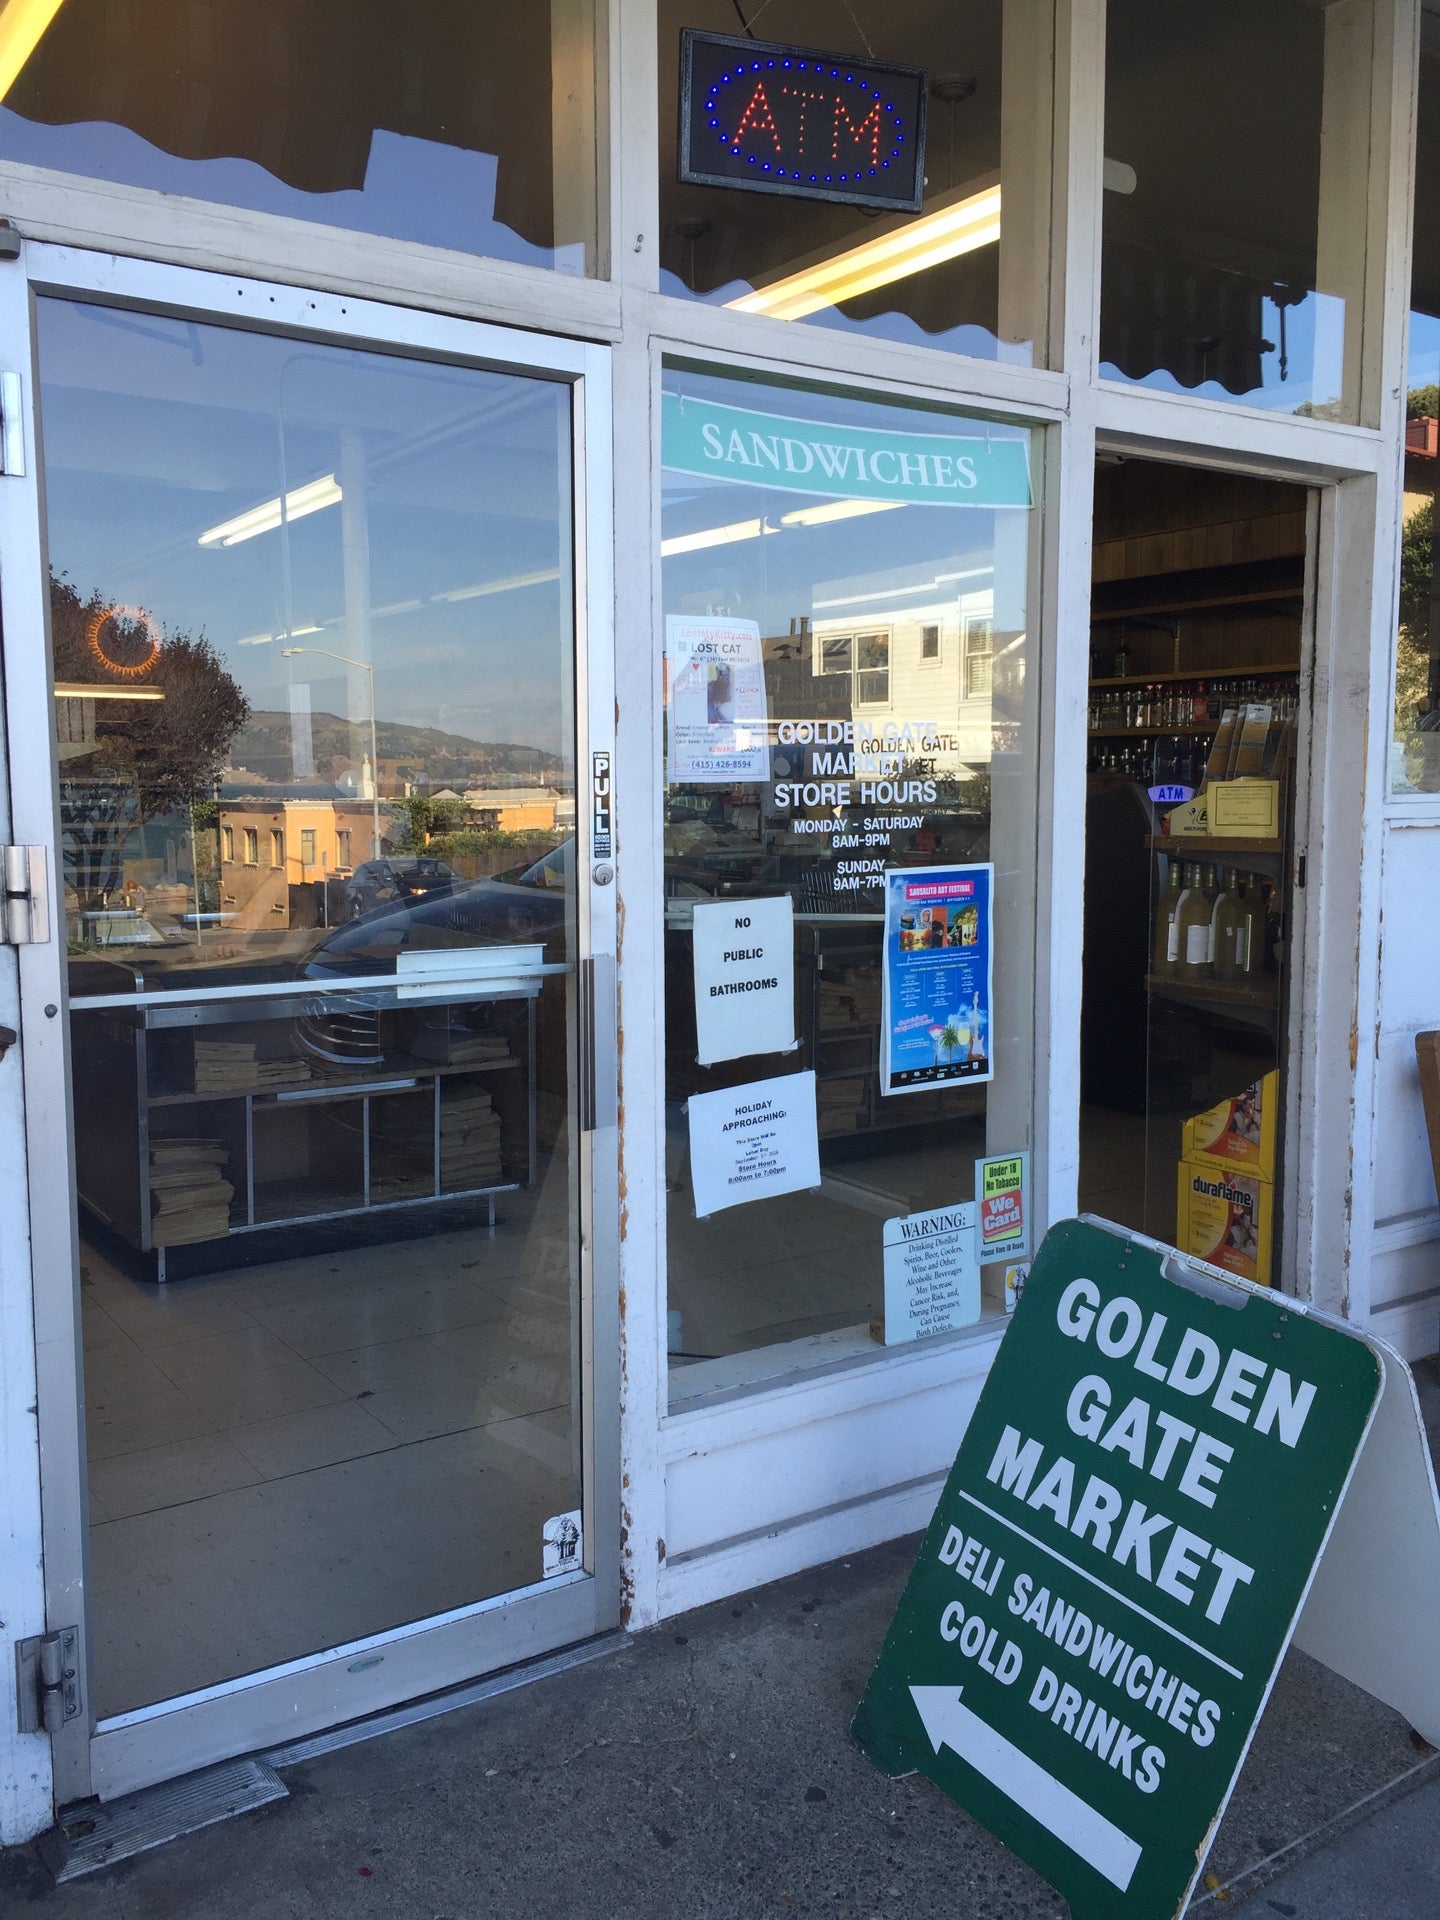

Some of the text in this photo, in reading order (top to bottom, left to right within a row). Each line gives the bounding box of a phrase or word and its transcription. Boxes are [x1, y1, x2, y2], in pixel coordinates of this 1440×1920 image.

[732, 81, 881, 166] ATM
[701, 423, 978, 489] SANDWICHES
[691, 643, 741, 654] LOST CAT
[778, 720, 938, 745] GOLDEN GATE
[691, 760, 752, 769] (415) 426-8594
[812, 751, 907, 776] MARKET
[594, 758, 610, 834] PULL
[774, 782, 851, 807] STORE
[860, 780, 937, 805] HOURS
[1158, 787, 1184, 800] ATM
[794, 818, 848, 834] MONDAY
[863, 815, 925, 831] SATURDAY
[832, 833, 890, 849] 8AM-9PM
[836, 859, 886, 875] SUNDAY
[833, 875, 887, 891] 9AM-7PM
[909, 884, 970, 896] SAUSALITO ART FESTIVAL
[735, 917, 751, 929] NO
[723, 948, 763, 963] PUBLIC
[710, 977, 778, 997] BATHROOMS
[735, 1100, 772, 1116] HOLIDAY
[738, 1159, 777, 1172] Store Hours
[989, 1164, 1008, 1178] Under
[986, 1176, 1020, 1191] No Tobacco
[1192, 1176, 1253, 1207] duraflame
[988, 1195, 1015, 1214] We
[900, 1212, 966, 1239] WARNING:
[983, 1206, 1021, 1231] Card
[908, 1234, 959, 1254] Drinking Distilled
[911, 1258, 956, 1274] Wine and Other
[906, 1268, 962, 1288] Alcoholic Beverages
[916, 1280, 953, 1296] May Increase
[909, 1296, 930, 1308] Cancer
[909, 1307, 929, 1319] During
[920, 1313, 950, 1326] Can Cause
[916, 1326, 931, 1338] Birth
[1056, 1277, 1317, 1449] GOLDEN
[1065, 1374, 1235, 1510] GATE
[985, 1425, 1255, 1626] MARKET
[937, 1523, 1223, 1748] DELI SANDWICHES
[938, 1600, 1166, 1795] COLD DRINKS
